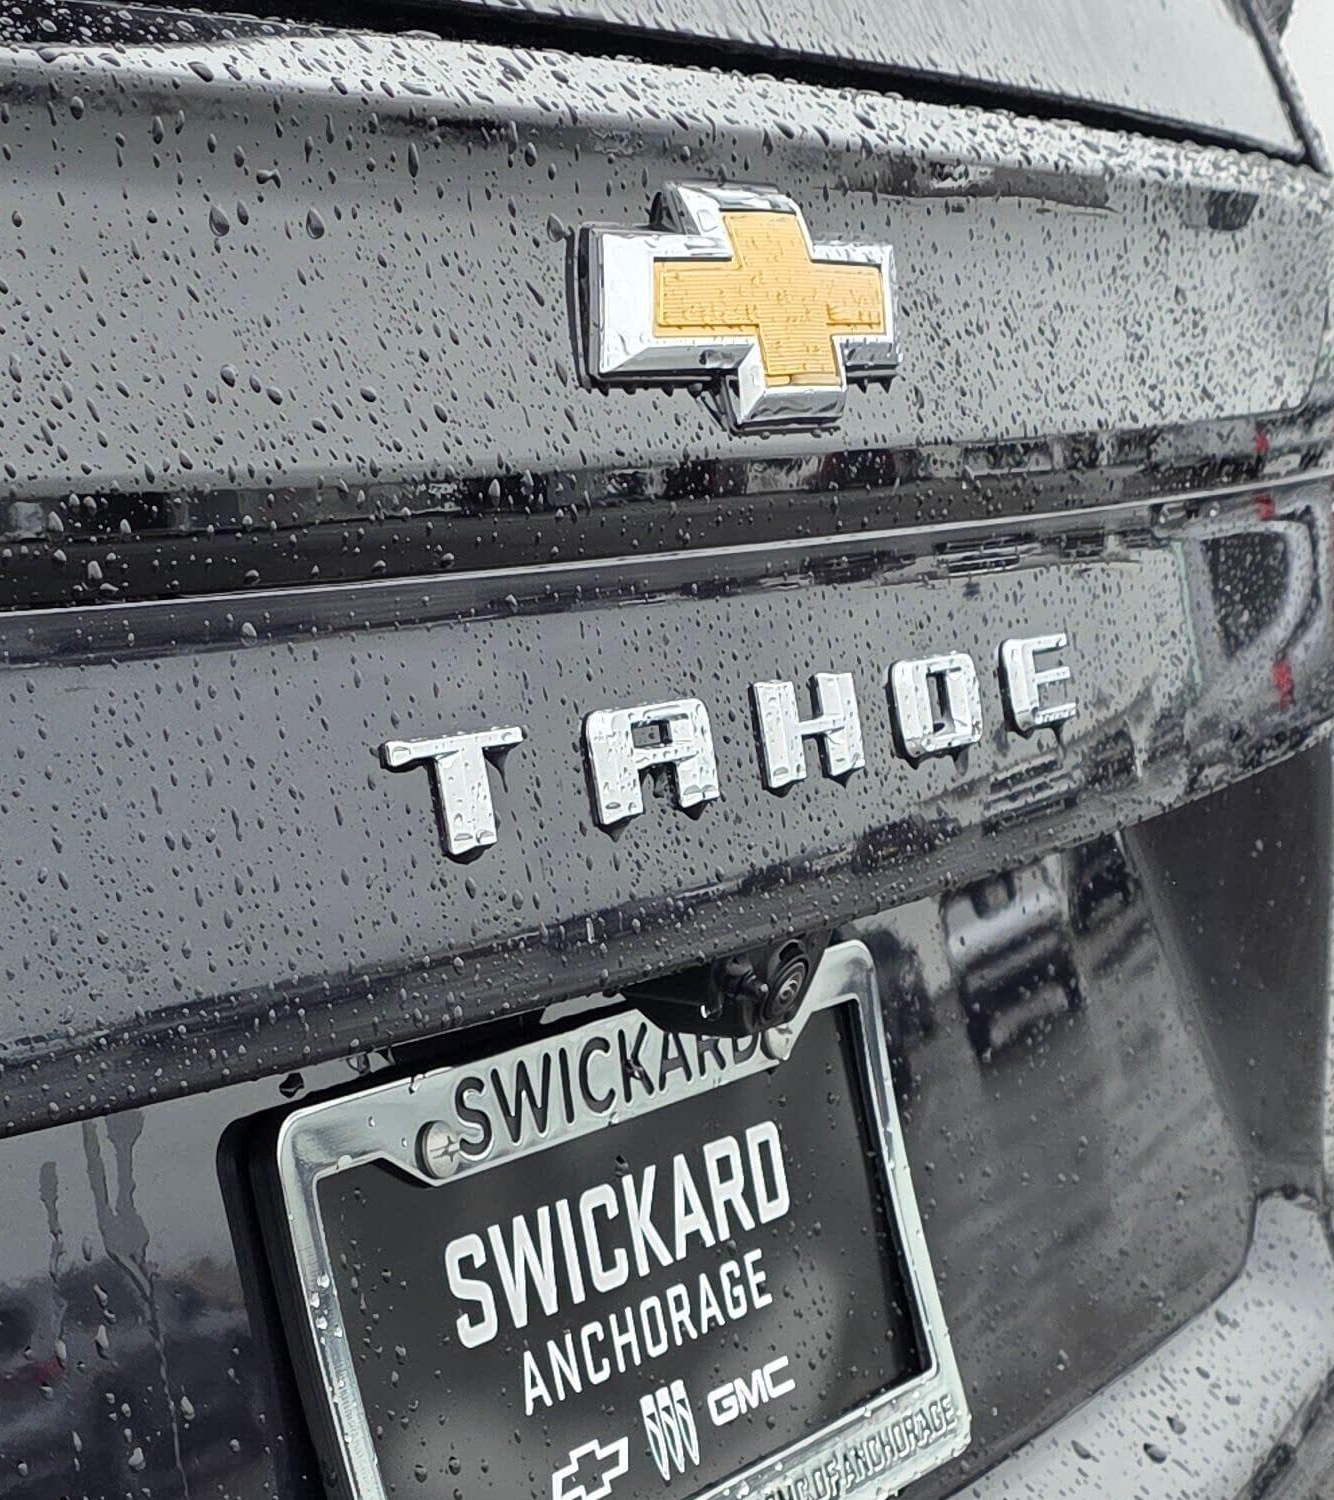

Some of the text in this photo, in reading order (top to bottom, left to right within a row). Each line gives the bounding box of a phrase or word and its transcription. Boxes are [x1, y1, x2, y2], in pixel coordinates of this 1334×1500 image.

[380, 632, 1077, 857] TAHOE
[443, 1119, 791, 1349] SWICKARD
[522, 1247, 773, 1416] ANCHORAGE
[706, 1355, 796, 1426] GMC
[841, 1393, 958, 1488] ANCHORAGE
